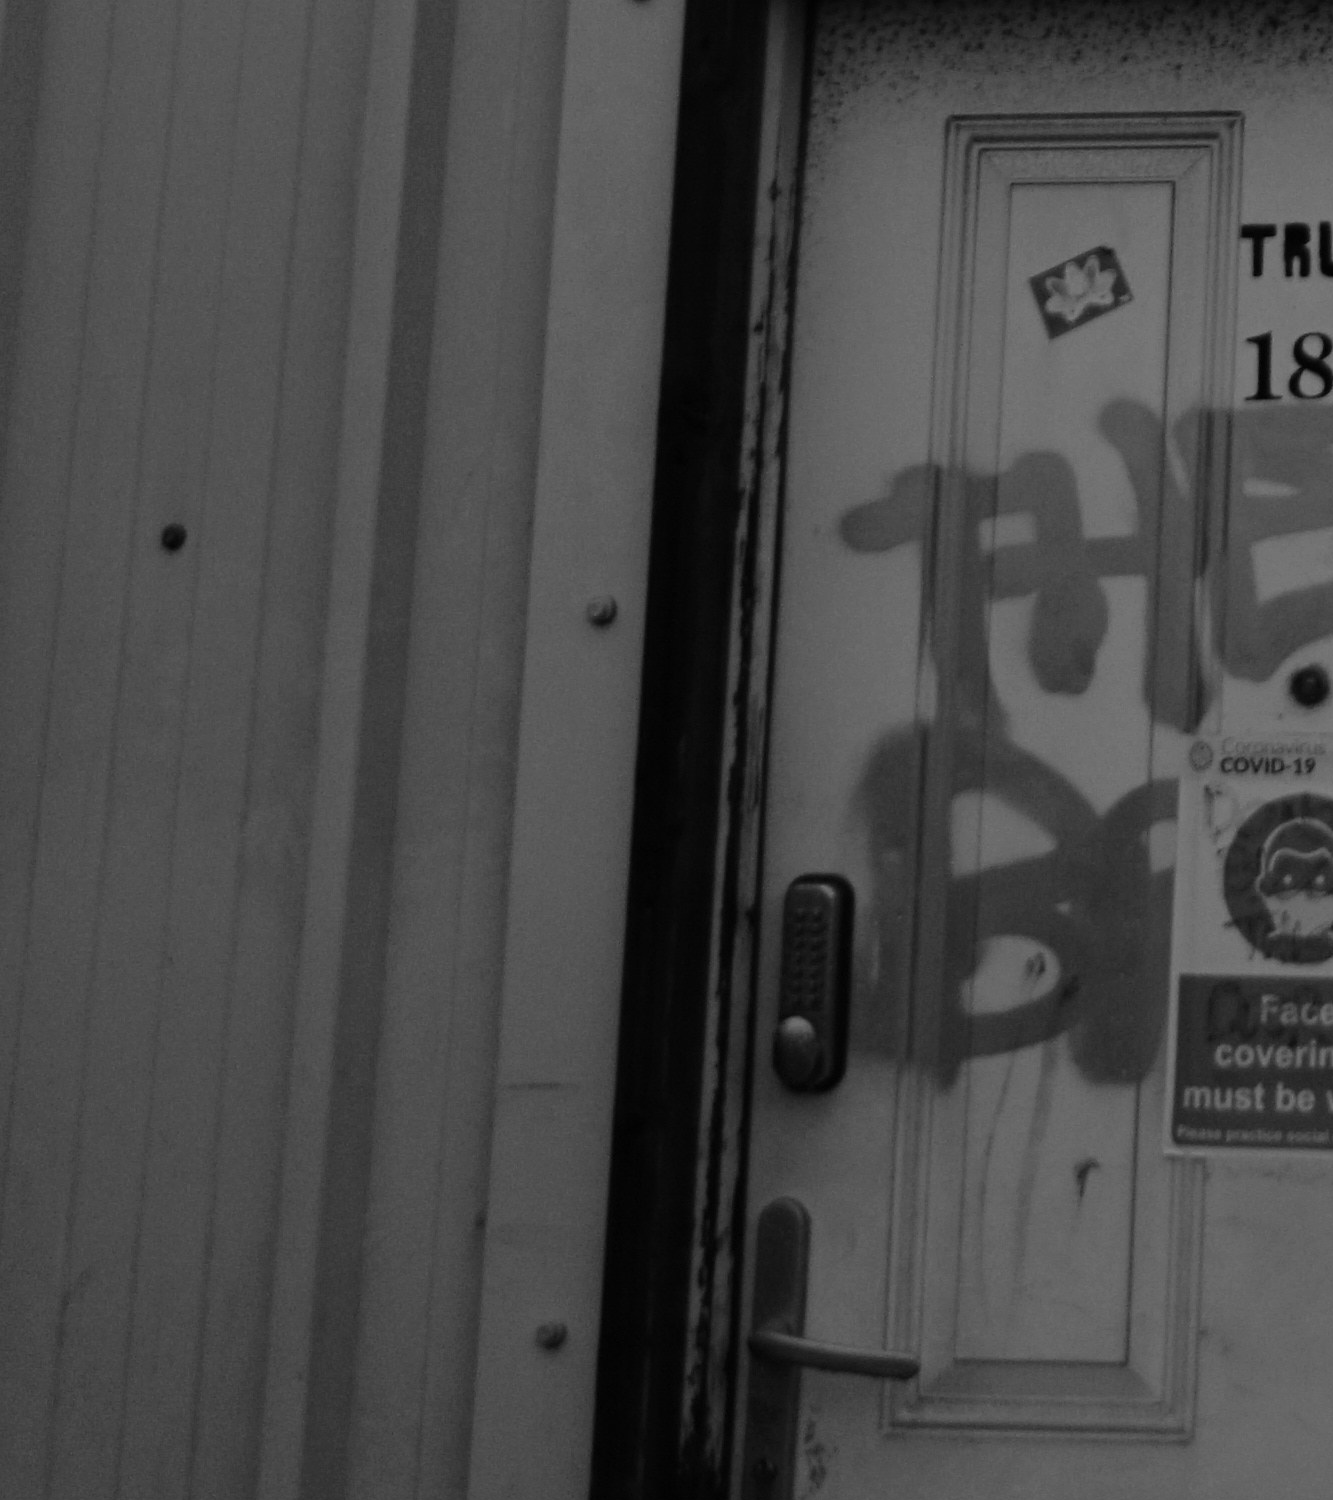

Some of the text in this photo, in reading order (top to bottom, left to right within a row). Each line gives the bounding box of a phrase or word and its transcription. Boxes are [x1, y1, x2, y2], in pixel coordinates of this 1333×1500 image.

[1219, 757, 1316, 775] COVID-19
[1183, 1083, 1265, 1112] must
[1275, 1082, 1316, 1113] be
[1176, 1124, 1222, 1141] Please
